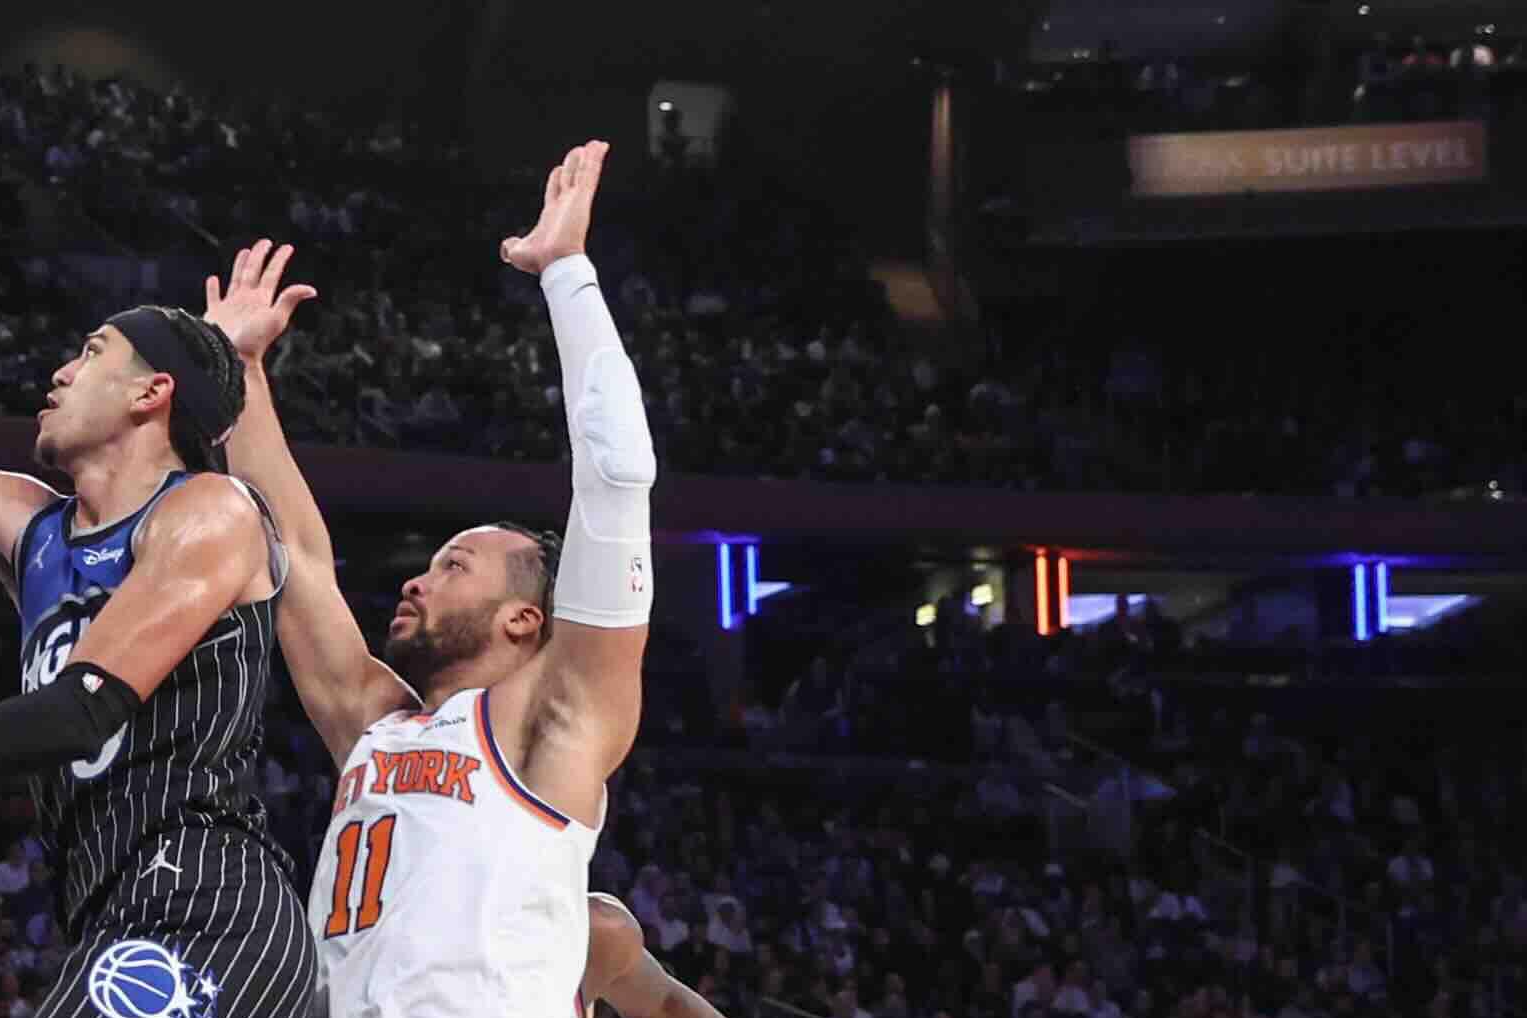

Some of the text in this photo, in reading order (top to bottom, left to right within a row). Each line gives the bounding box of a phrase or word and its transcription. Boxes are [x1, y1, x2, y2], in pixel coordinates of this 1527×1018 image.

[1370, 139, 1474, 170] LEVEL
[370, 748, 482, 808] YORK
[323, 813, 398, 940] 11
